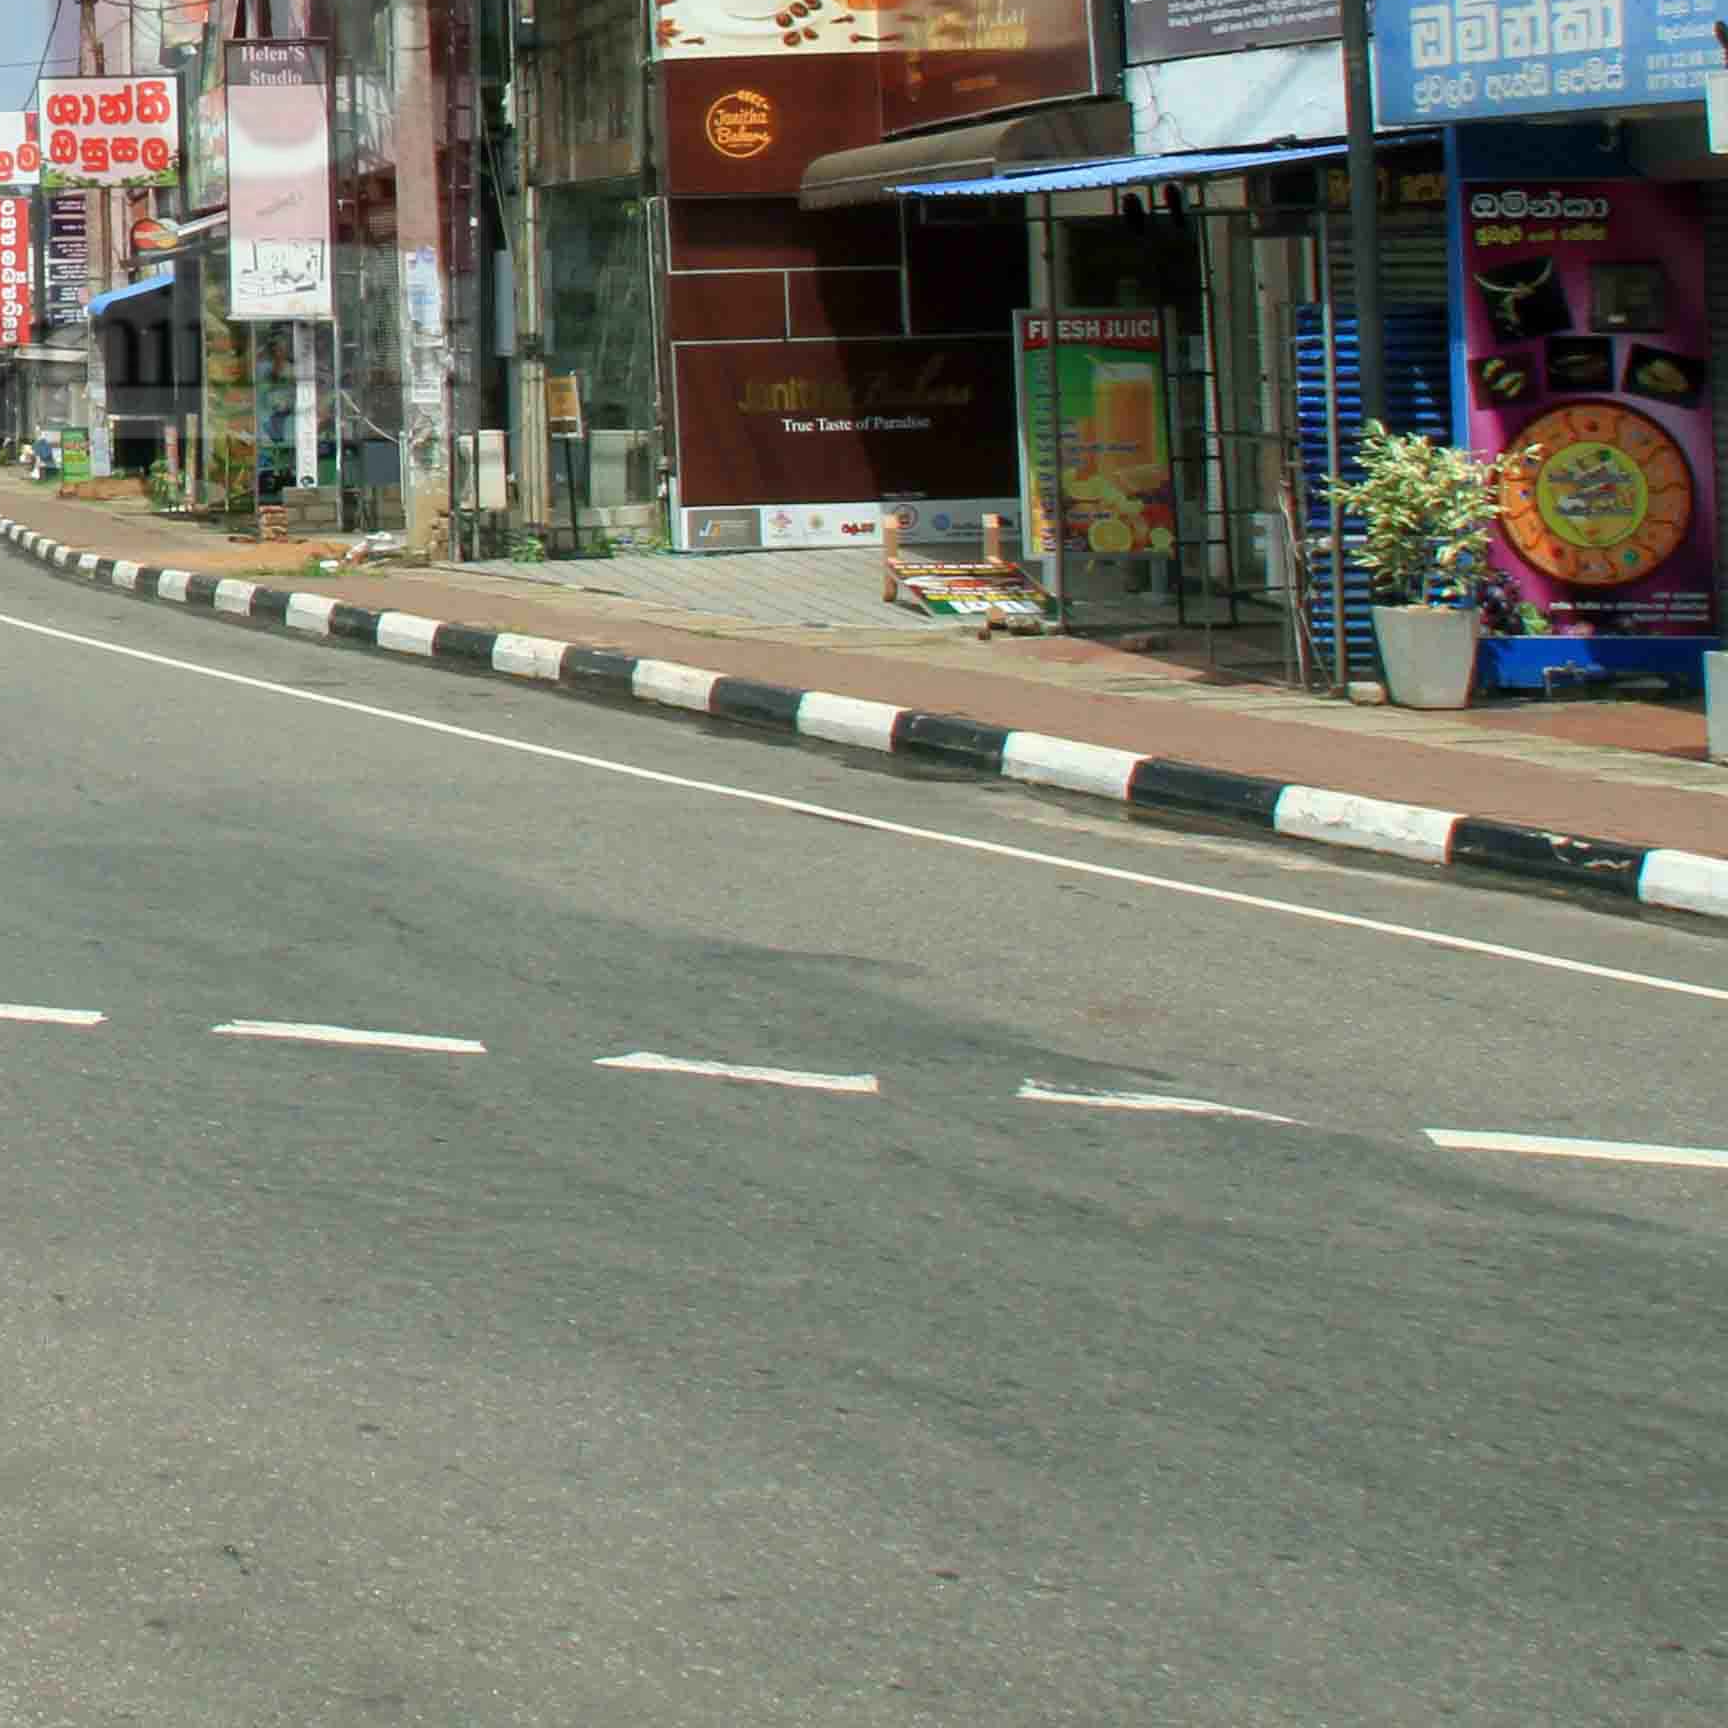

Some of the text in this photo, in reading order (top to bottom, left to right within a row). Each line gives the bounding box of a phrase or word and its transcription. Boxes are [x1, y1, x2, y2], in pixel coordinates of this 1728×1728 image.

[249, 71, 304, 86] Studio
[49, 129, 170, 172] ඔසුසල
[781, 418, 815, 433] True
[817, 417, 853, 432] Taste
[855, 416, 871, 431] of
